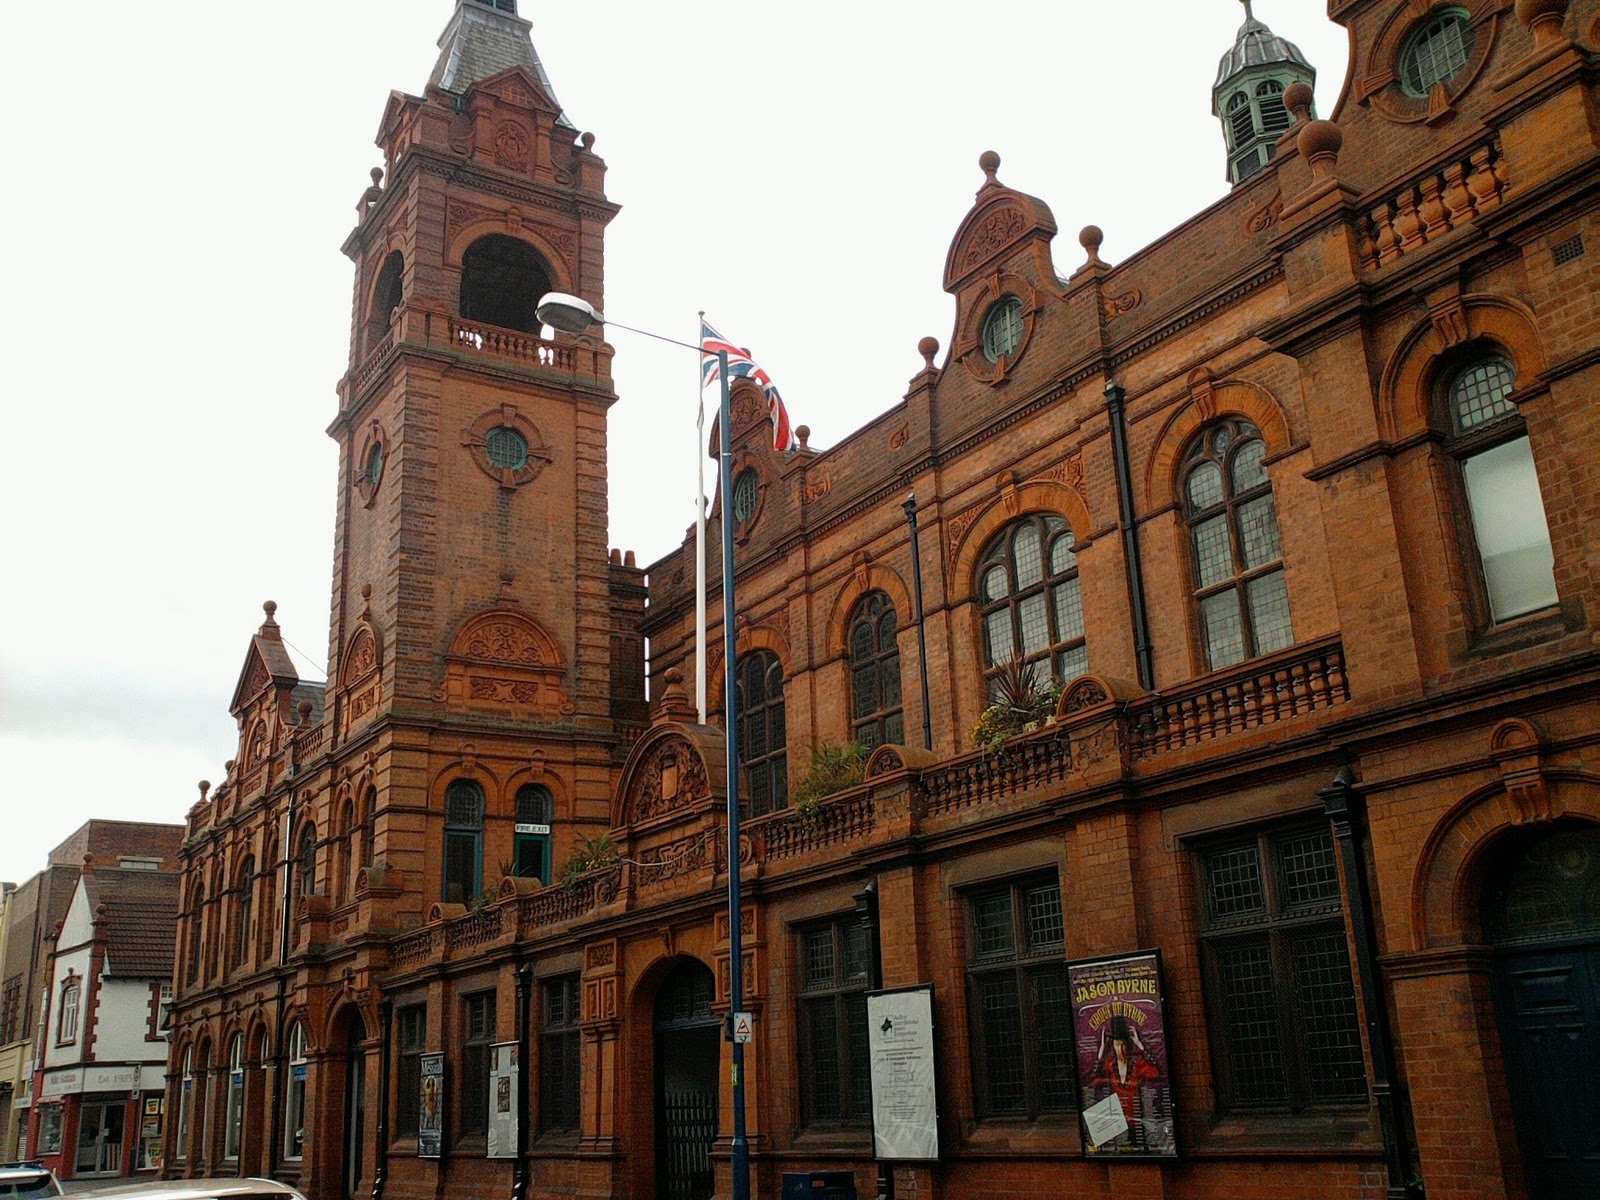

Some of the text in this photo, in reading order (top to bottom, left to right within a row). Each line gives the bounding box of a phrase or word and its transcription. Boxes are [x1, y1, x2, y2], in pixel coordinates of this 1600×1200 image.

[532, 825, 549, 833] EXIT
[1076, 978, 1156, 1003] JASON BYRNE
